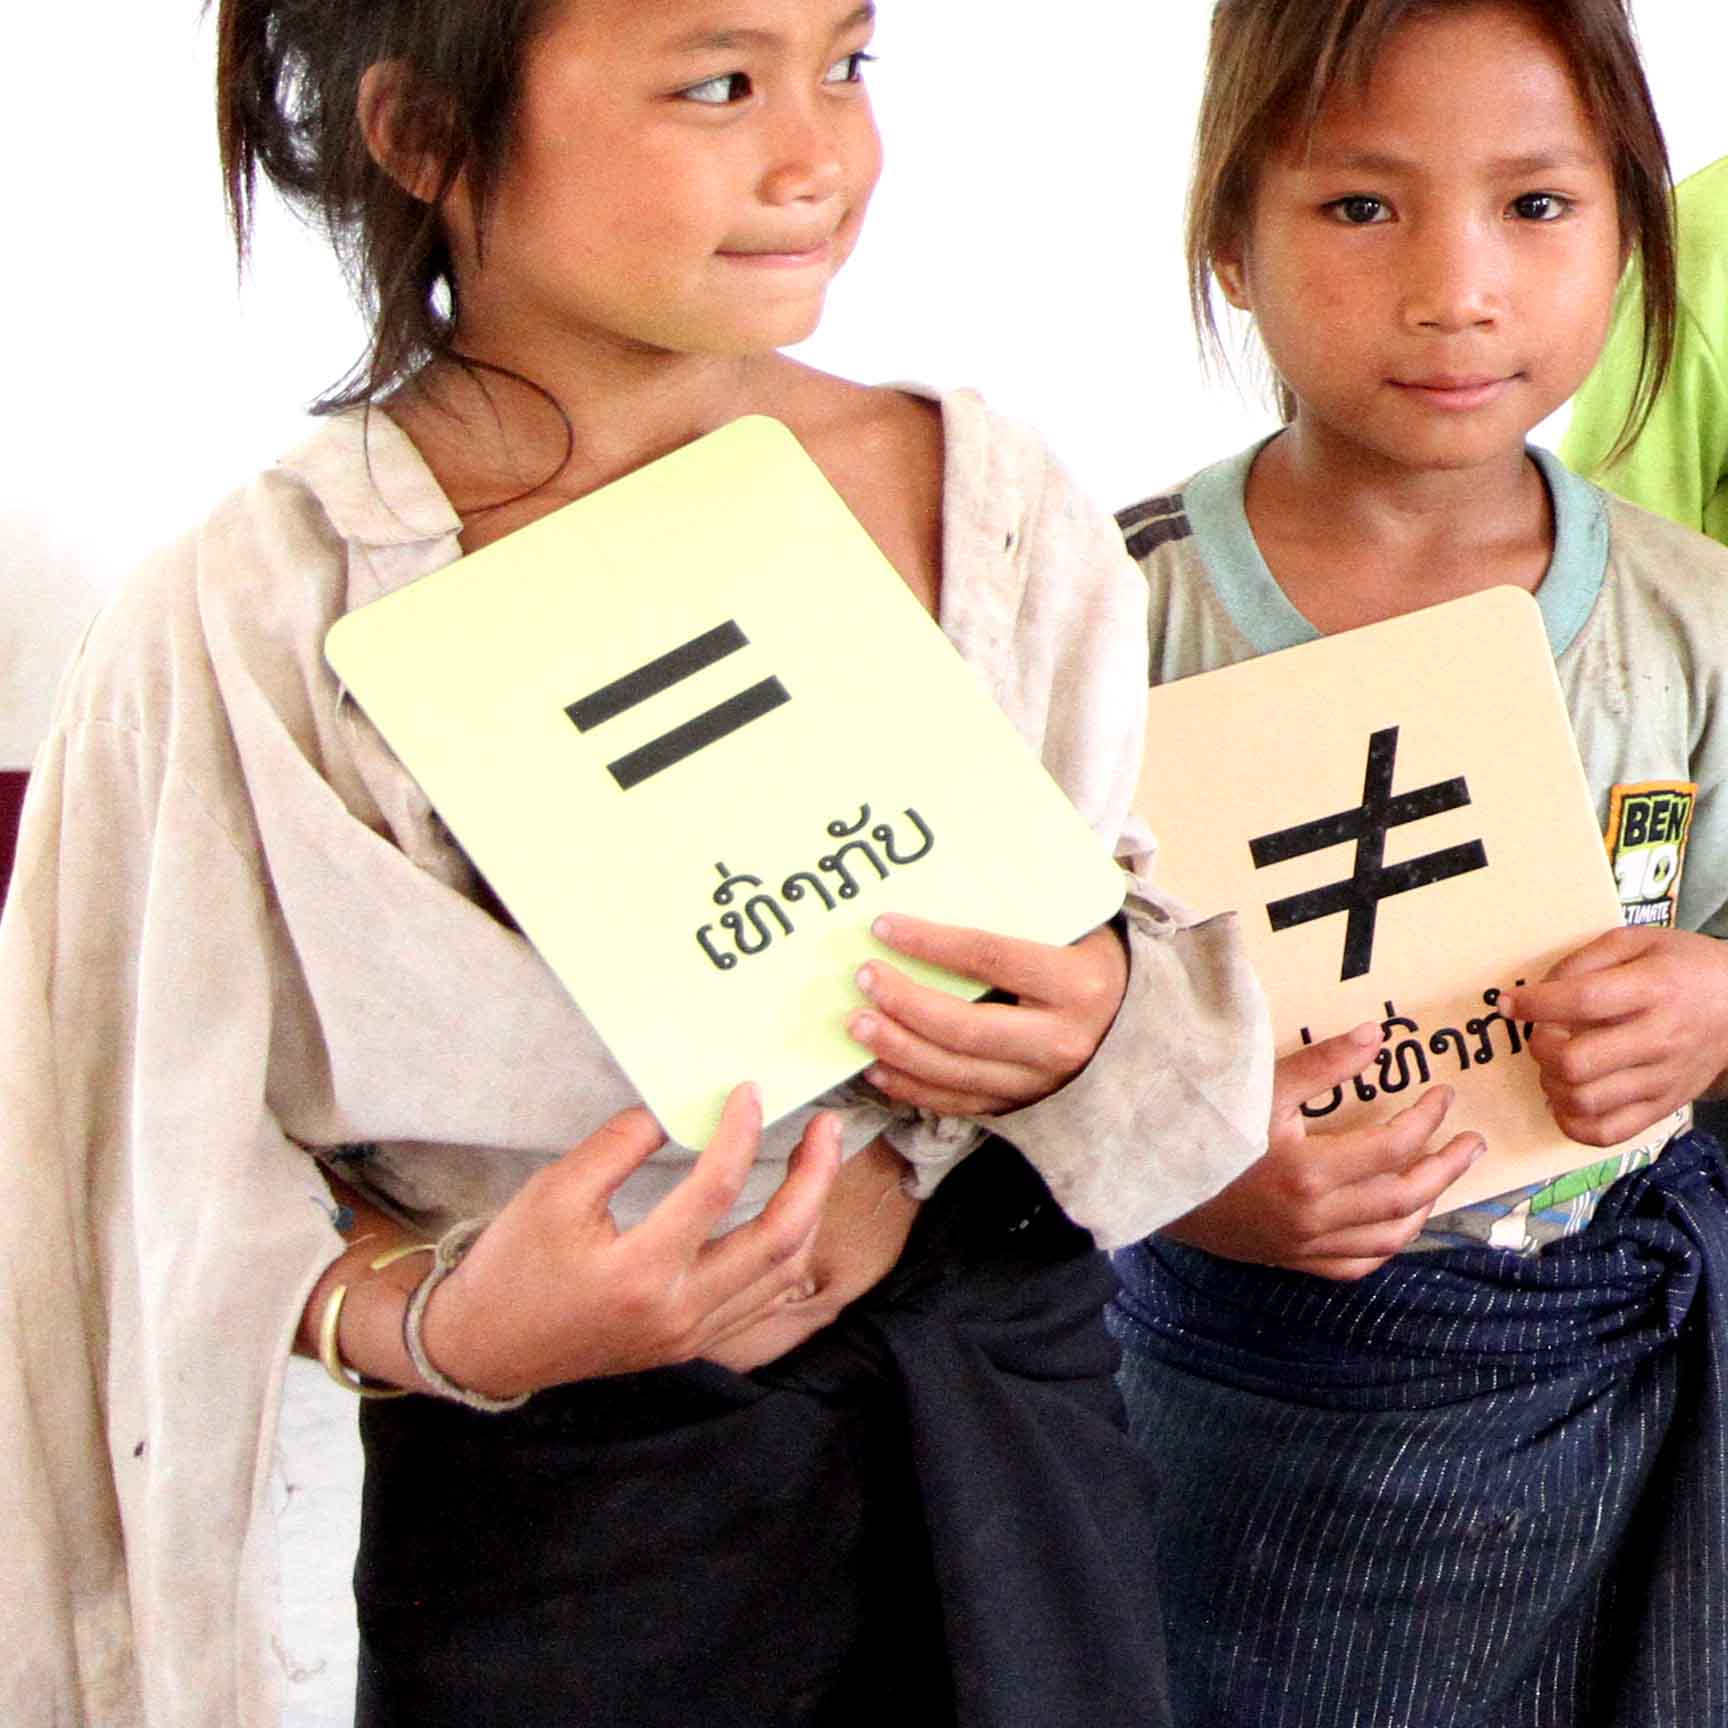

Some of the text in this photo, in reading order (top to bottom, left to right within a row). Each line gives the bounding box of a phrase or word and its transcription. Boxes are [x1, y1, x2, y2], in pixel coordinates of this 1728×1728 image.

[1623, 798, 1688, 847] BEN
[696, 803, 935, 971] ເທົ່າກັບ
[1616, 843, 1680, 902] 10
